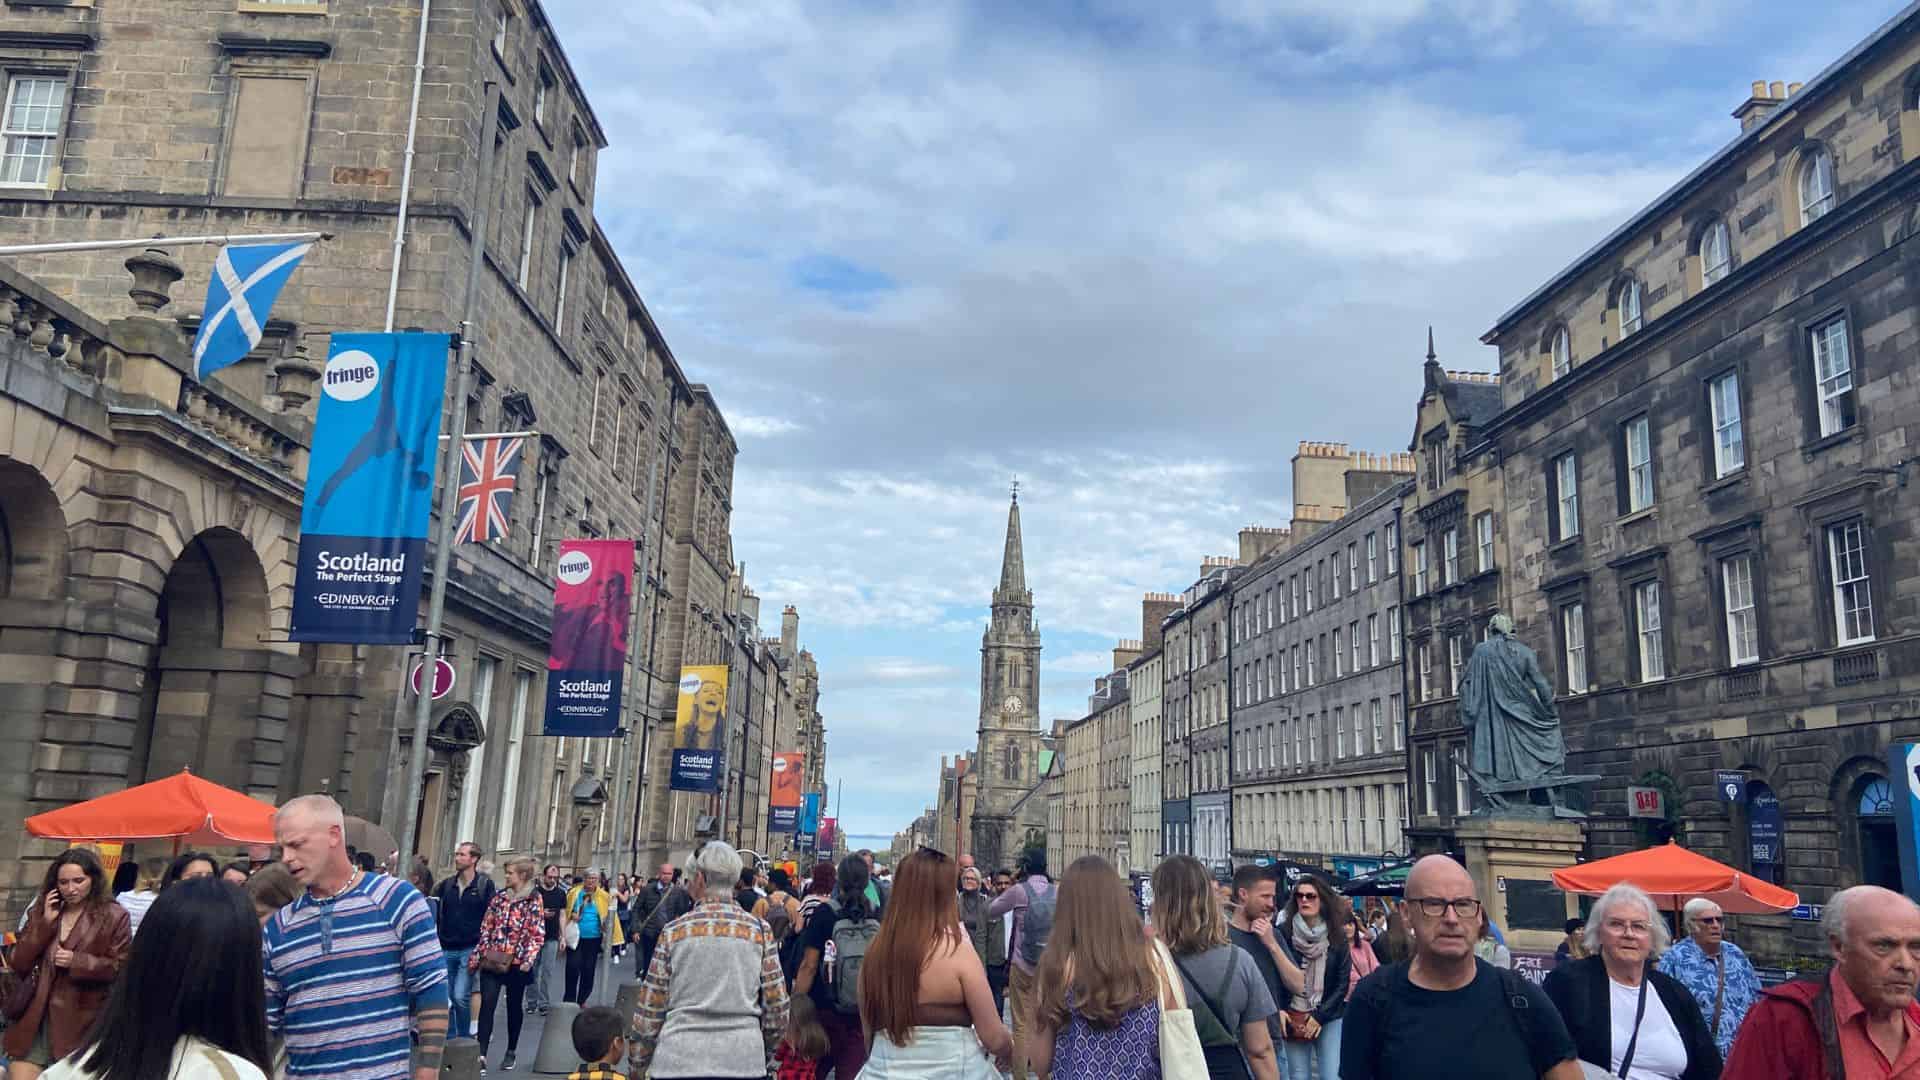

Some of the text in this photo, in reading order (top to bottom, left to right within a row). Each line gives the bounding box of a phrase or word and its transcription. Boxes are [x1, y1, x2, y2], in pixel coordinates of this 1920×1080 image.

[327, 366, 375, 384] fringe
[317, 551, 405, 572] Scotland
[560, 561, 589, 573] fringe
[316, 571, 402, 584] The Perfect Stage
[560, 680, 611, 692] Scotland
[680, 755, 713, 764] Scotland
